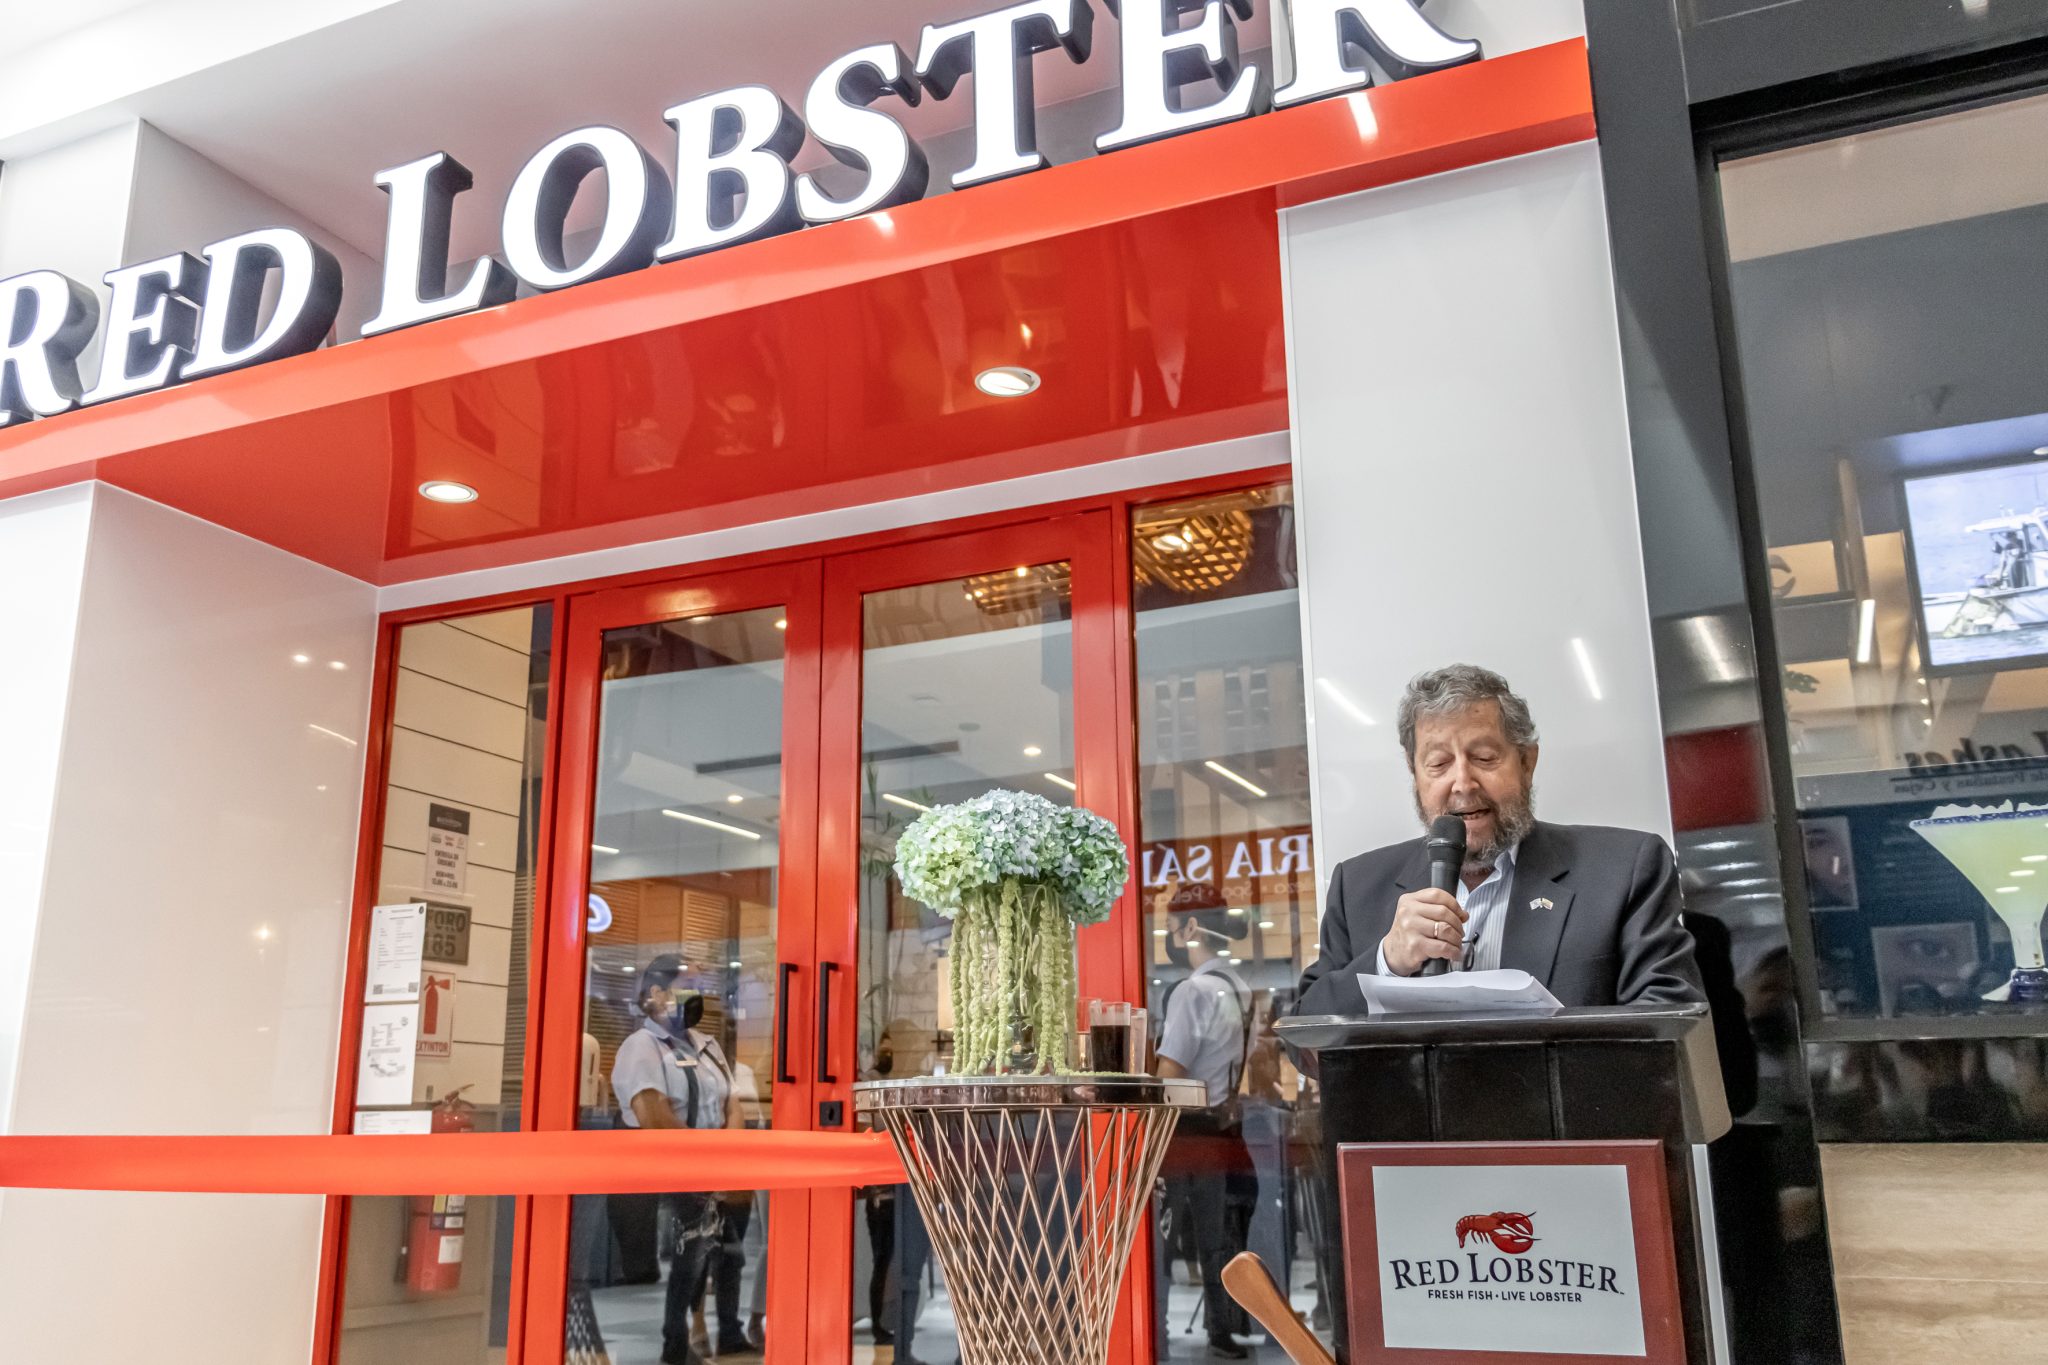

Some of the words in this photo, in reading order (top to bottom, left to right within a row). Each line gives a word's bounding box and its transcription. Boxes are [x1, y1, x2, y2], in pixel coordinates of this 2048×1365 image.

[0, 226, 316, 426] RED
[1389, 1258, 1459, 1290] RED
[1466, 1252, 1621, 1295] LOBSTER
[1428, 1289, 1464, 1300] FRESH
[1468, 1290, 1493, 1301] FISH
[1501, 1291, 1526, 1301] LIVE
[1530, 1292, 1582, 1303] LOBSTER
